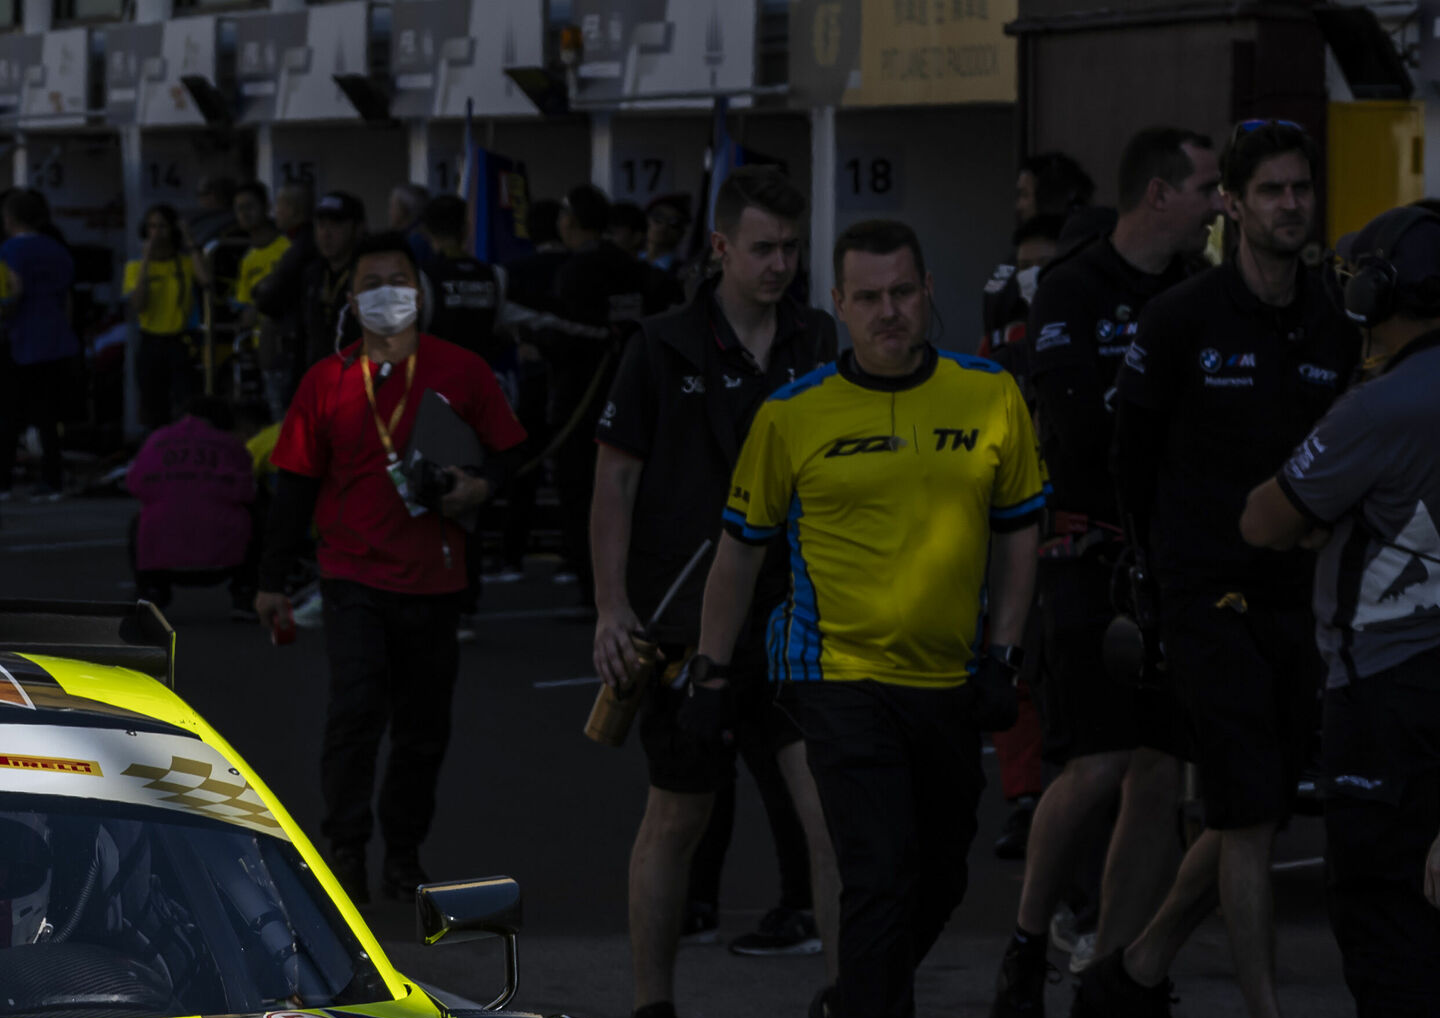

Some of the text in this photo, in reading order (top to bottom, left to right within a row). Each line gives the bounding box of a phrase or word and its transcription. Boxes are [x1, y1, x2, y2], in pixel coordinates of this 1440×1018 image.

[149, 162, 181, 188] 14
[281, 161, 315, 187] 15
[622, 158, 664, 192] 17
[846, 157, 892, 195] 18
[934, 428, 979, 451] TW
